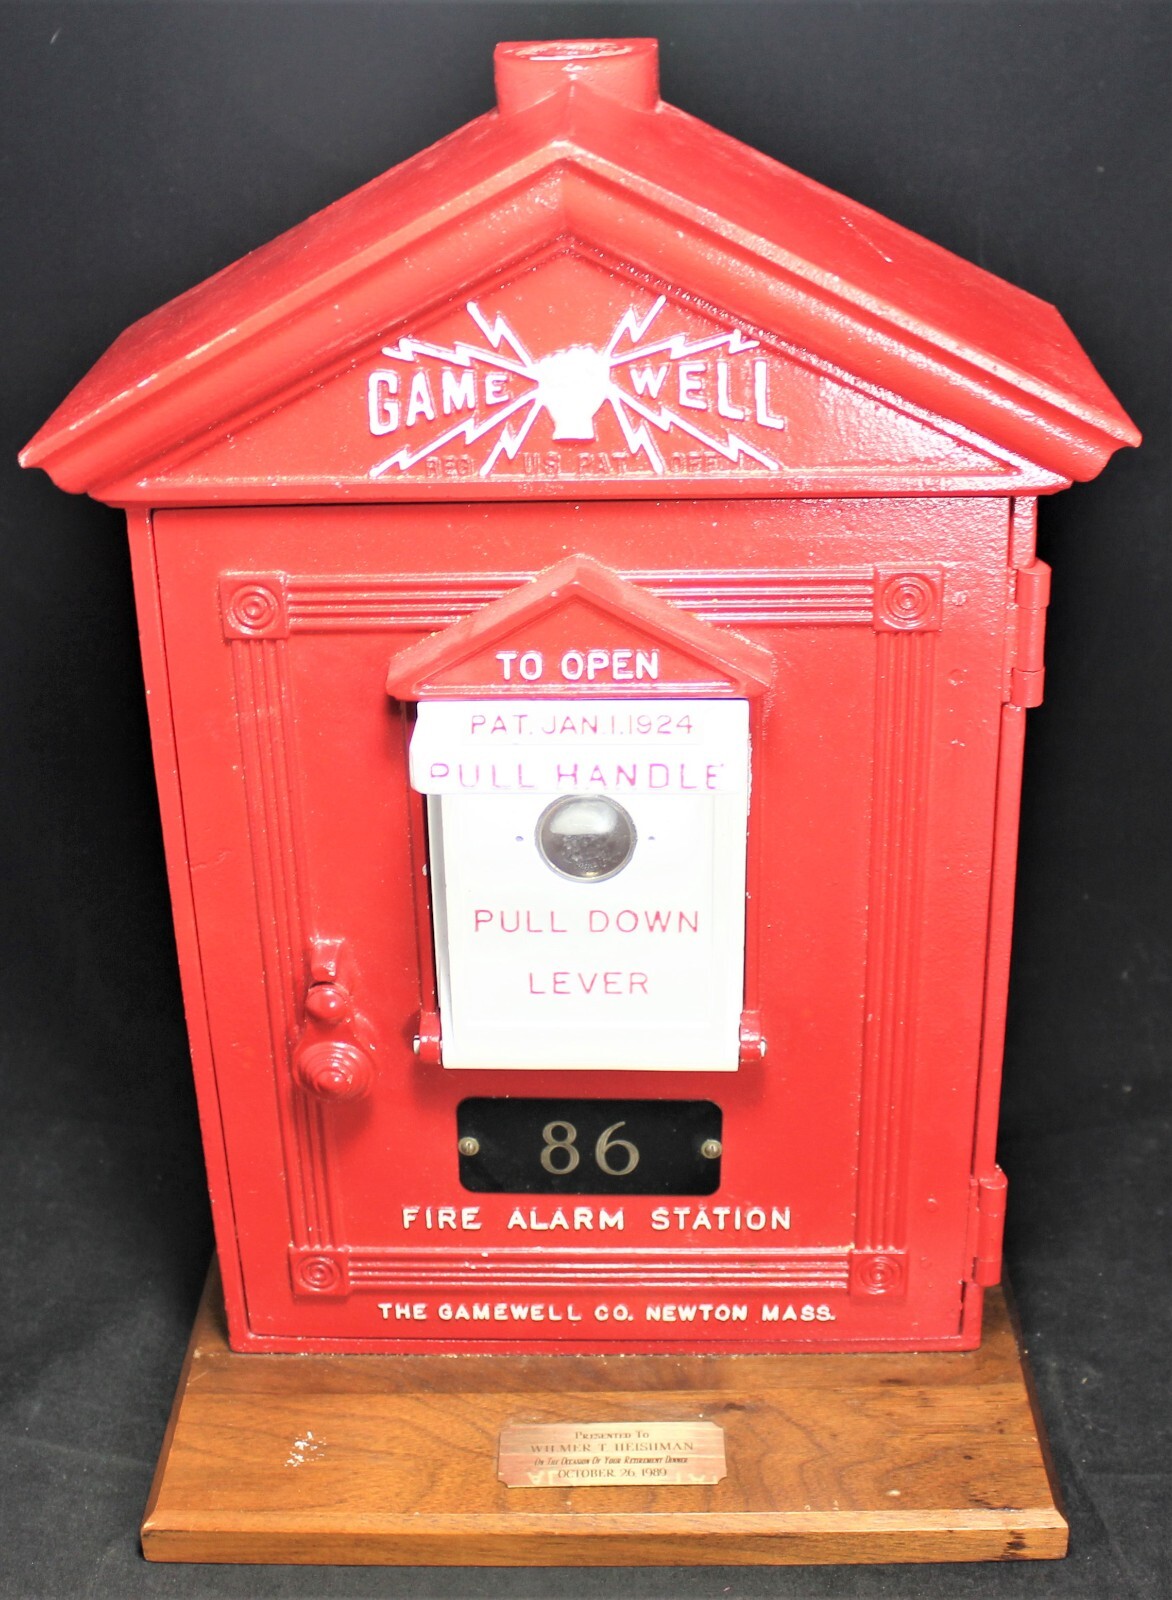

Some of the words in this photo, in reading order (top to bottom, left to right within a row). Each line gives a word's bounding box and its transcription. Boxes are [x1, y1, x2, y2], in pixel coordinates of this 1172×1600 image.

[368, 368, 509, 436] GAME
[629, 359, 785, 430] WELL
[495, 651, 543, 681] TO
[561, 649, 660, 681] OPEN
[430, 763, 535, 790] PULL
[556, 763, 724, 790] HANDLE
[474, 909, 568, 933] PULL
[588, 909, 699, 933] DOWN
[529, 971, 649, 995] LEVER
[540, 1120, 640, 1176] 86
[402, 1206, 482, 1231] FIRE
[507, 1206, 625, 1231] ALARM
[651, 1206, 792, 1231] STATION
[377, 1303, 427, 1321] THE
[438, 1303, 582, 1321] GAMEWELL
[594, 1303, 634, 1321] CO.
[646, 1303, 748, 1321] NEWTON
[762, 1303, 836, 1321] MASS.
[531, 1443, 591, 1453] WILMER
[558, 1469, 615, 1478] OCTOBER
[641, 1468, 668, 1477] 1989
